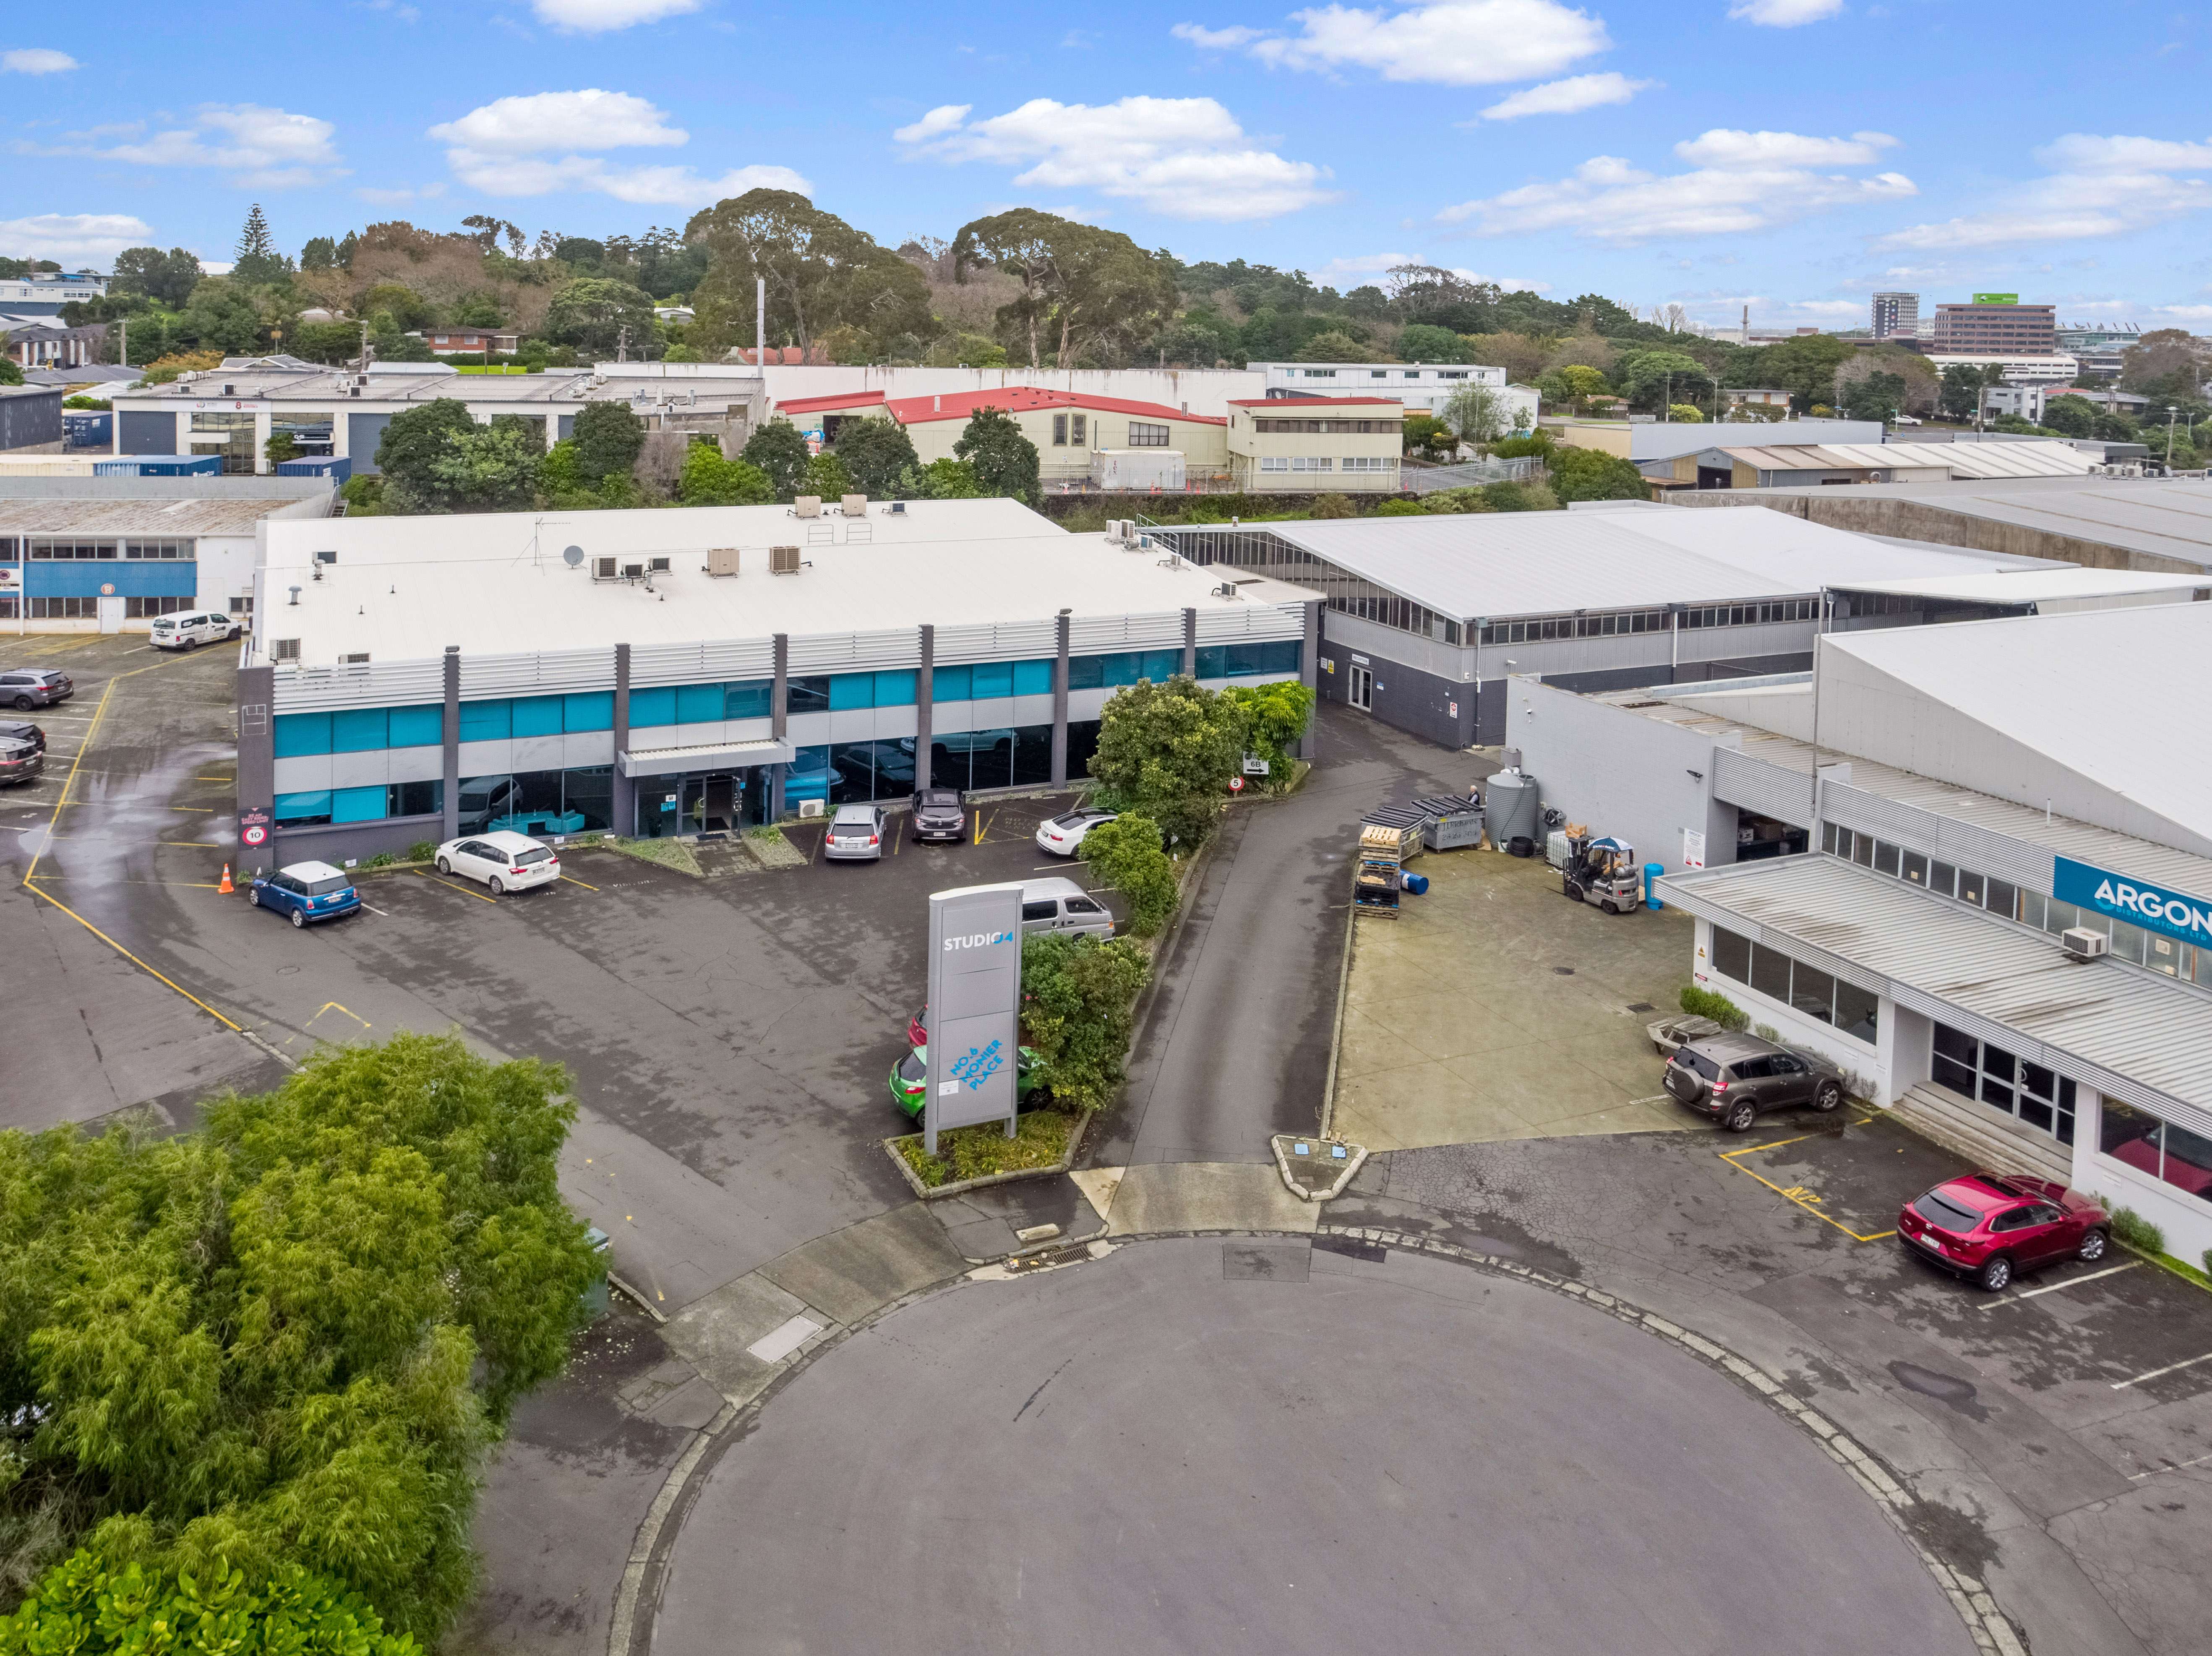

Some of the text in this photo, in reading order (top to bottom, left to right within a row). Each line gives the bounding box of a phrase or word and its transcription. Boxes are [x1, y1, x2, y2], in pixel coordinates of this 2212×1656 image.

[2094, 879, 2212, 937] ARGON
[2116, 906, 2207, 941] DISTRIBUTORS LTD
[959, 1039, 1003, 1083] MONIER
[969, 1055, 1004, 1091] PLACE
